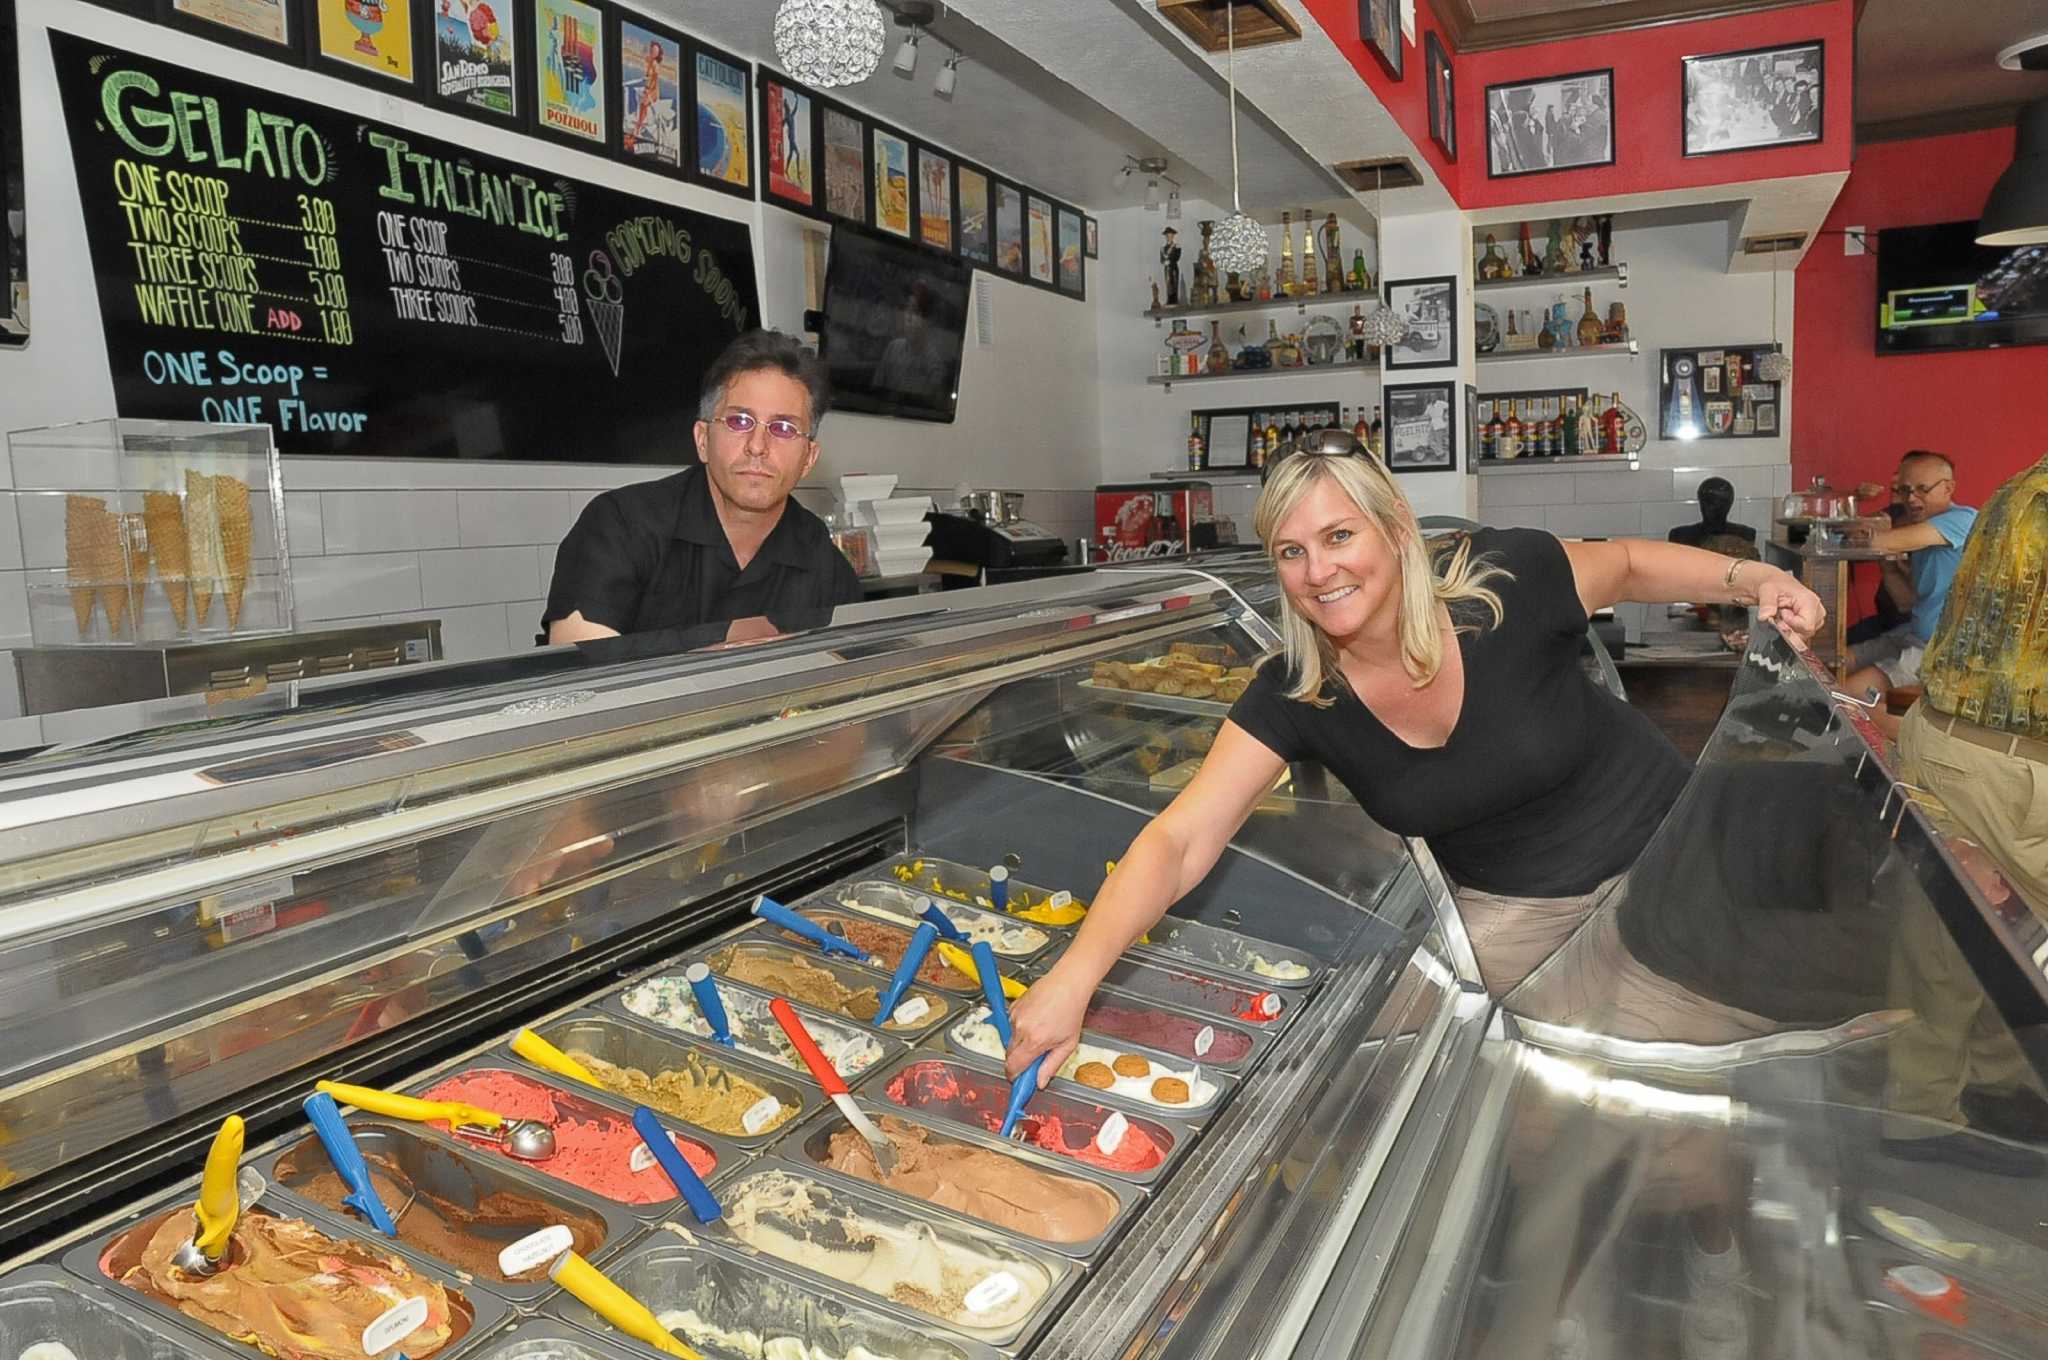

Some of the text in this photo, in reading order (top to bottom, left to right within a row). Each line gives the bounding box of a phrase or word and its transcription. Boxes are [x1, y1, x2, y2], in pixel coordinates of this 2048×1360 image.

[101, 70, 327, 187] GELATO
[114, 159, 336, 235] ONE SCOOP 3.00
[368, 131, 570, 242] ITALIAN ICE
[118, 200, 172, 244] TWO
[172, 211, 243, 257] SCOOPS
[376, 210, 410, 250] ONE
[409, 215, 449, 257] SCOOP
[127, 241, 198, 285] THREE
[198, 251, 260, 295] SCOOPS
[381, 247, 415, 284] TWO
[415, 252, 463, 293] SCOOPS
[605, 216, 748, 333] COMING SOON
[134, 283, 215, 330] WAFFLE
[214, 290, 260, 335] CONE
[267, 307, 303, 332] ADD
[389, 286, 436, 323] THREE
[433, 291, 479, 328] SCOOPS
[143, 350, 214, 387] ONE
[217, 350, 304, 397] Scoop
[201, 396, 369, 432] ONE Flavor
